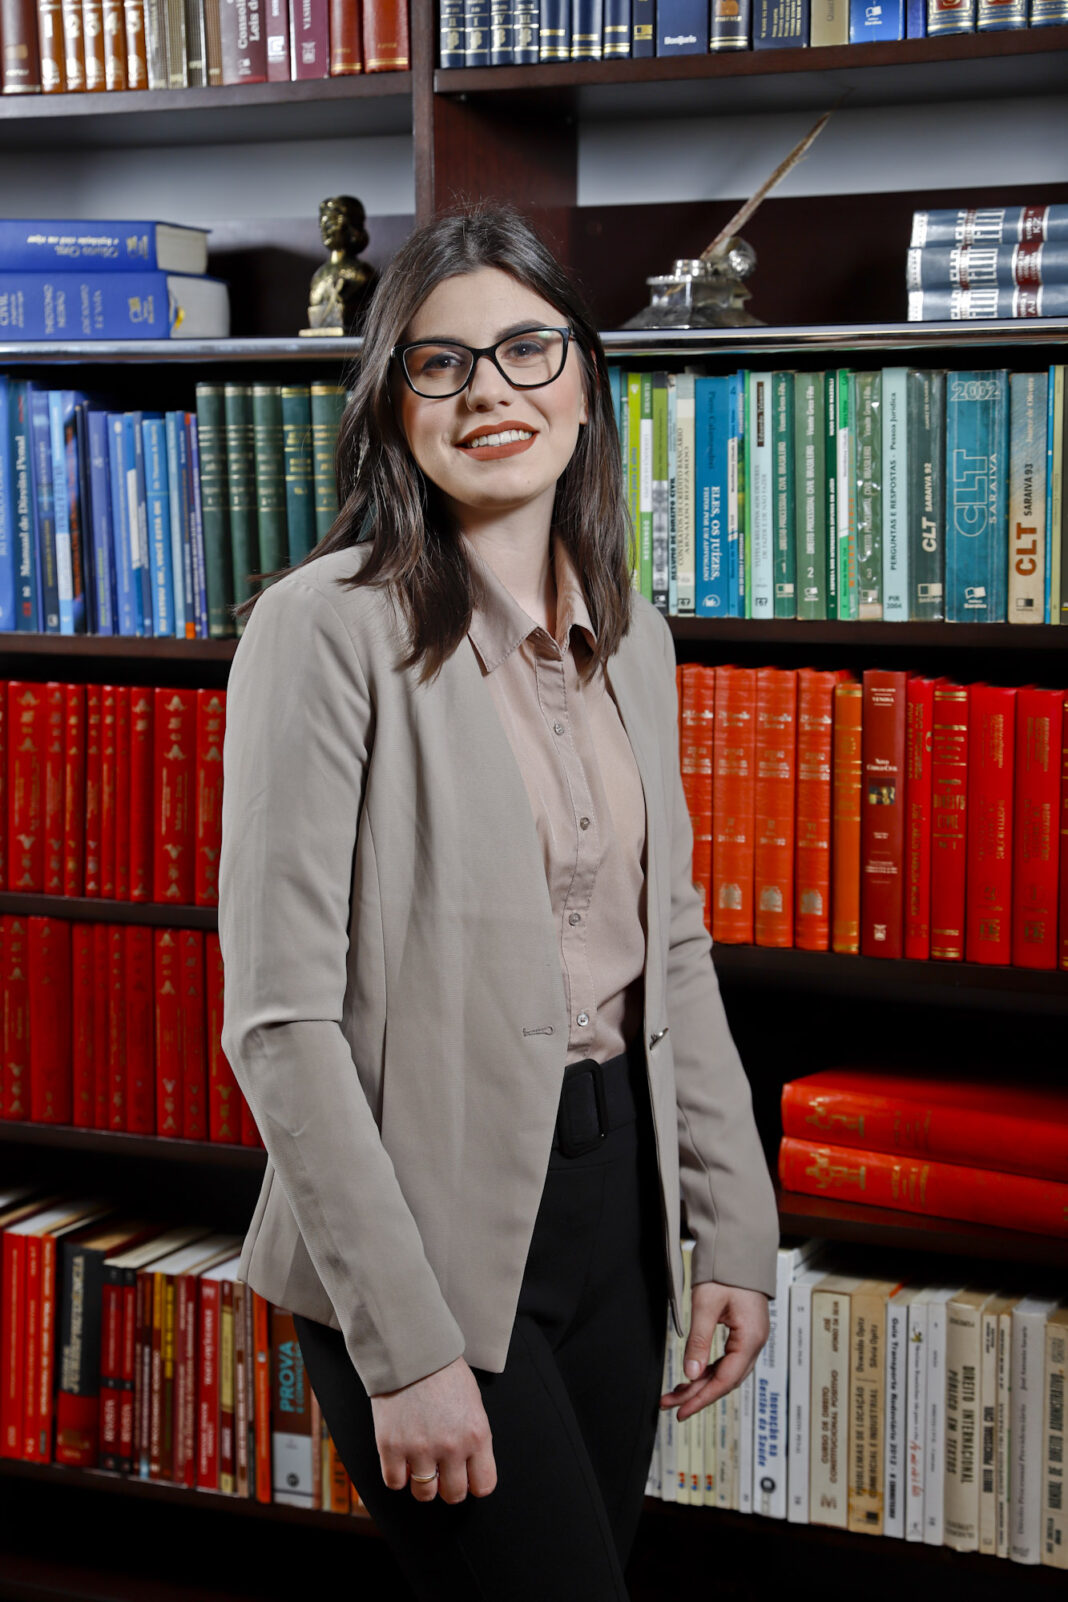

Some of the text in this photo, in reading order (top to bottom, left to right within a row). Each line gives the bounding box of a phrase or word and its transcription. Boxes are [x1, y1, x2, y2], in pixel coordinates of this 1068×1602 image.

[889, 392, 897, 422] Jurídica
[951, 380, 1001, 401] 2002
[15, 435, 26, 469] Penal
[889, 424, 897, 450] Pessoa
[889, 460, 897, 508] RESPOSTAS
[988, 453, 998, 525] SARAIVA
[1023, 463, 1033, 475] 93
[17, 471, 28, 513] Direito
[922, 463, 937, 552] CLT SARAIVA 92
[953, 449, 988, 537] CLT
[1024, 476, 1033, 517] SARAIVA
[710, 519, 721, 536] OS
[889, 518, 897, 570] PERGUNTAS
[1015, 522, 1037, 576] CLT
[20, 532, 31, 577] Manual
[807, 567, 814, 579] 2
[769, 1322, 777, 1368] Christensen
[891, 1317, 899, 1338] Guia
[278, 1341, 295, 1412] PROVA
[890, 1341, 899, 1389] Transporte
[758, 1378, 768, 1414] Gestão
[855, 1387, 864, 1427] LOCAÇÃO
[868, 1390, 877, 1440] INDUSTRIAL
[889, 1393, 898, 1440] Rodoviário
[758, 1418, 768, 1430] da
[769, 1392, 779, 1457] Inovação na
[822, 1420, 829, 1432] DE
[830, 1370, 838, 1484] CONSTITUCIONAL POSITIVO
[947, 1369, 959, 1475] PÚBLICO EM TEXTOS
[961, 1365, 975, 1484] DIREITO INTERNACIONAL
[855, 1444, 864, 1496] PROBLEMAS
[869, 1451, 878, 1498] COMERCIAL
[890, 1443, 898, 1465] 2012
[1018, 1462, 1026, 1504] Processual
[1018, 1506, 1026, 1534] Direito
